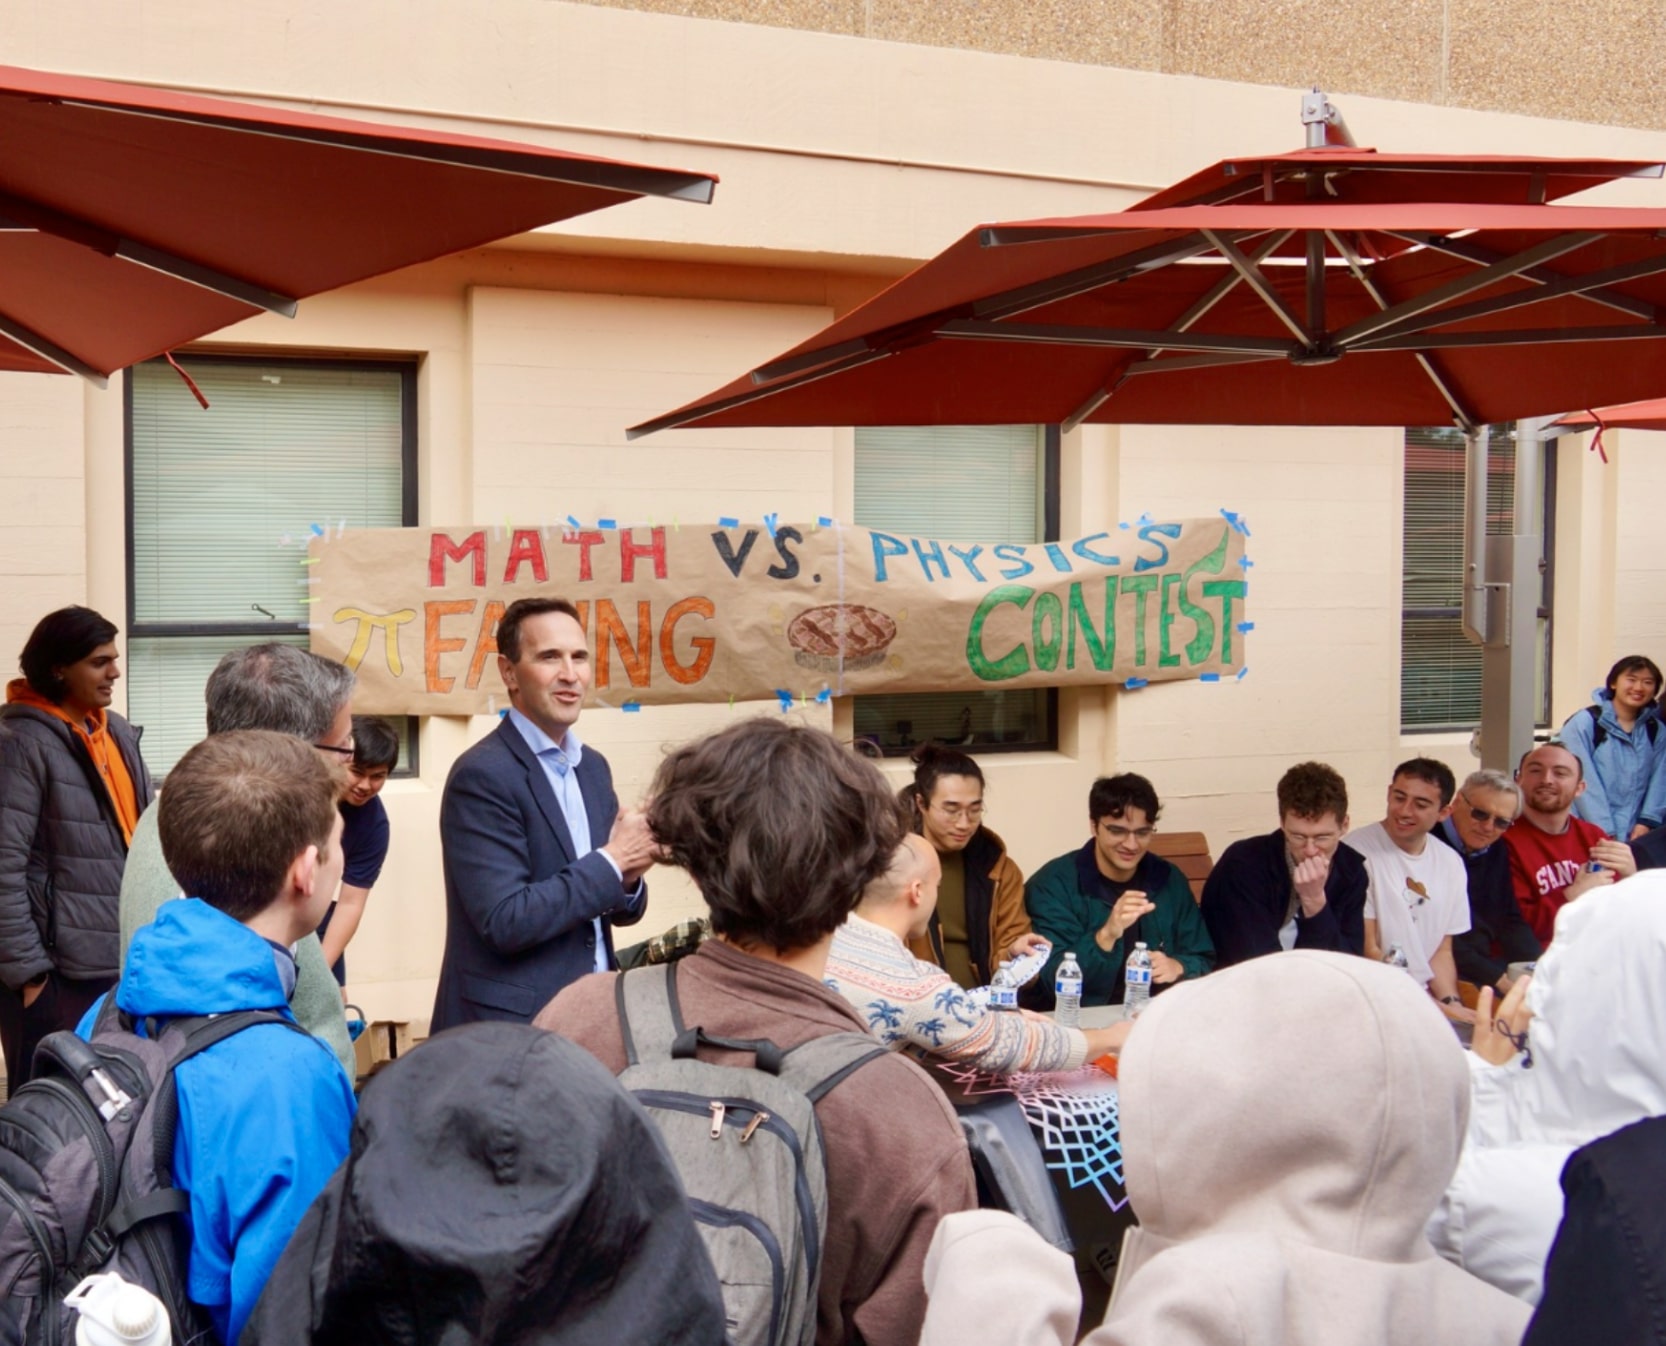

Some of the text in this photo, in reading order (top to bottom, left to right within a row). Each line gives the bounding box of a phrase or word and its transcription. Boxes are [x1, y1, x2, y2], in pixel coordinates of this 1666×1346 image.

[424, 596, 715, 693] EANG
[966, 526, 1245, 681] CONTEST
[429, 524, 1182, 587] MATH VS. PHYSICS
